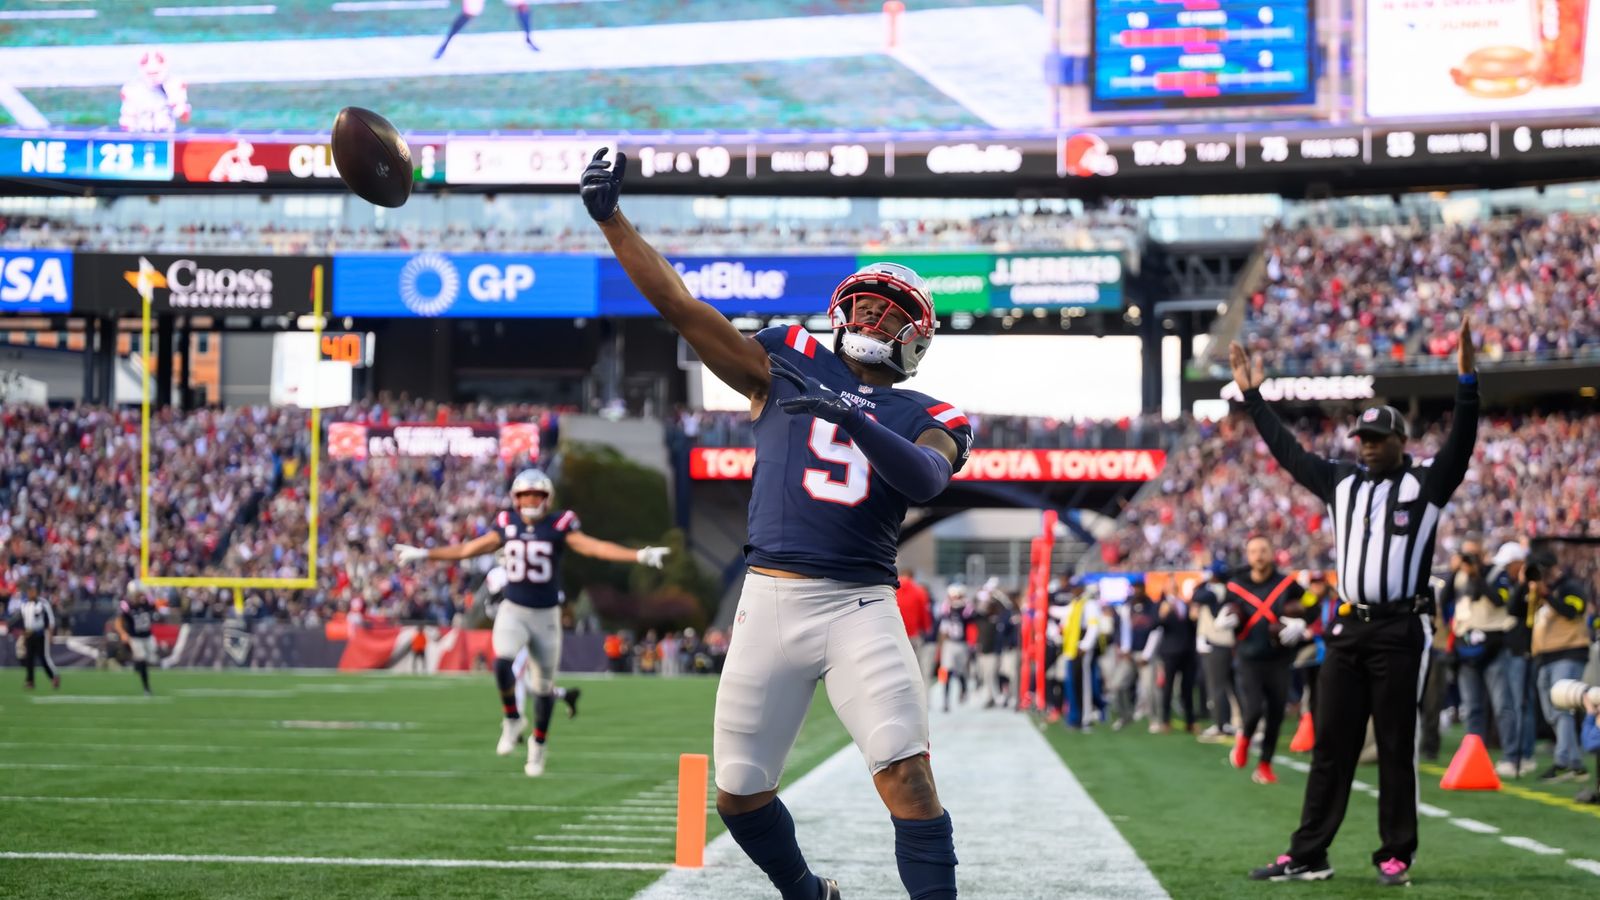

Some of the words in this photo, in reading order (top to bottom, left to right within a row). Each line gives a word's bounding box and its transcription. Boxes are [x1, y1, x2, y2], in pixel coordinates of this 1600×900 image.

[21, 141, 66, 173] NE
[289, 144, 339, 178] CL
[695, 146, 730, 177] 10
[0, 257, 68, 302] SA
[467, 263, 536, 301] GP
[676, 262, 788, 299] etBlue
[169, 292, 272, 309] INSURANCE
[321, 334, 361, 367] 40
[840, 390, 876, 410] PATRIOTS
[1259, 375, 1374, 401] UTODESK
[701, 449, 756, 478] TOY
[1045, 450, 1159, 480] TOYOTA
[504, 540, 552, 583] 85
